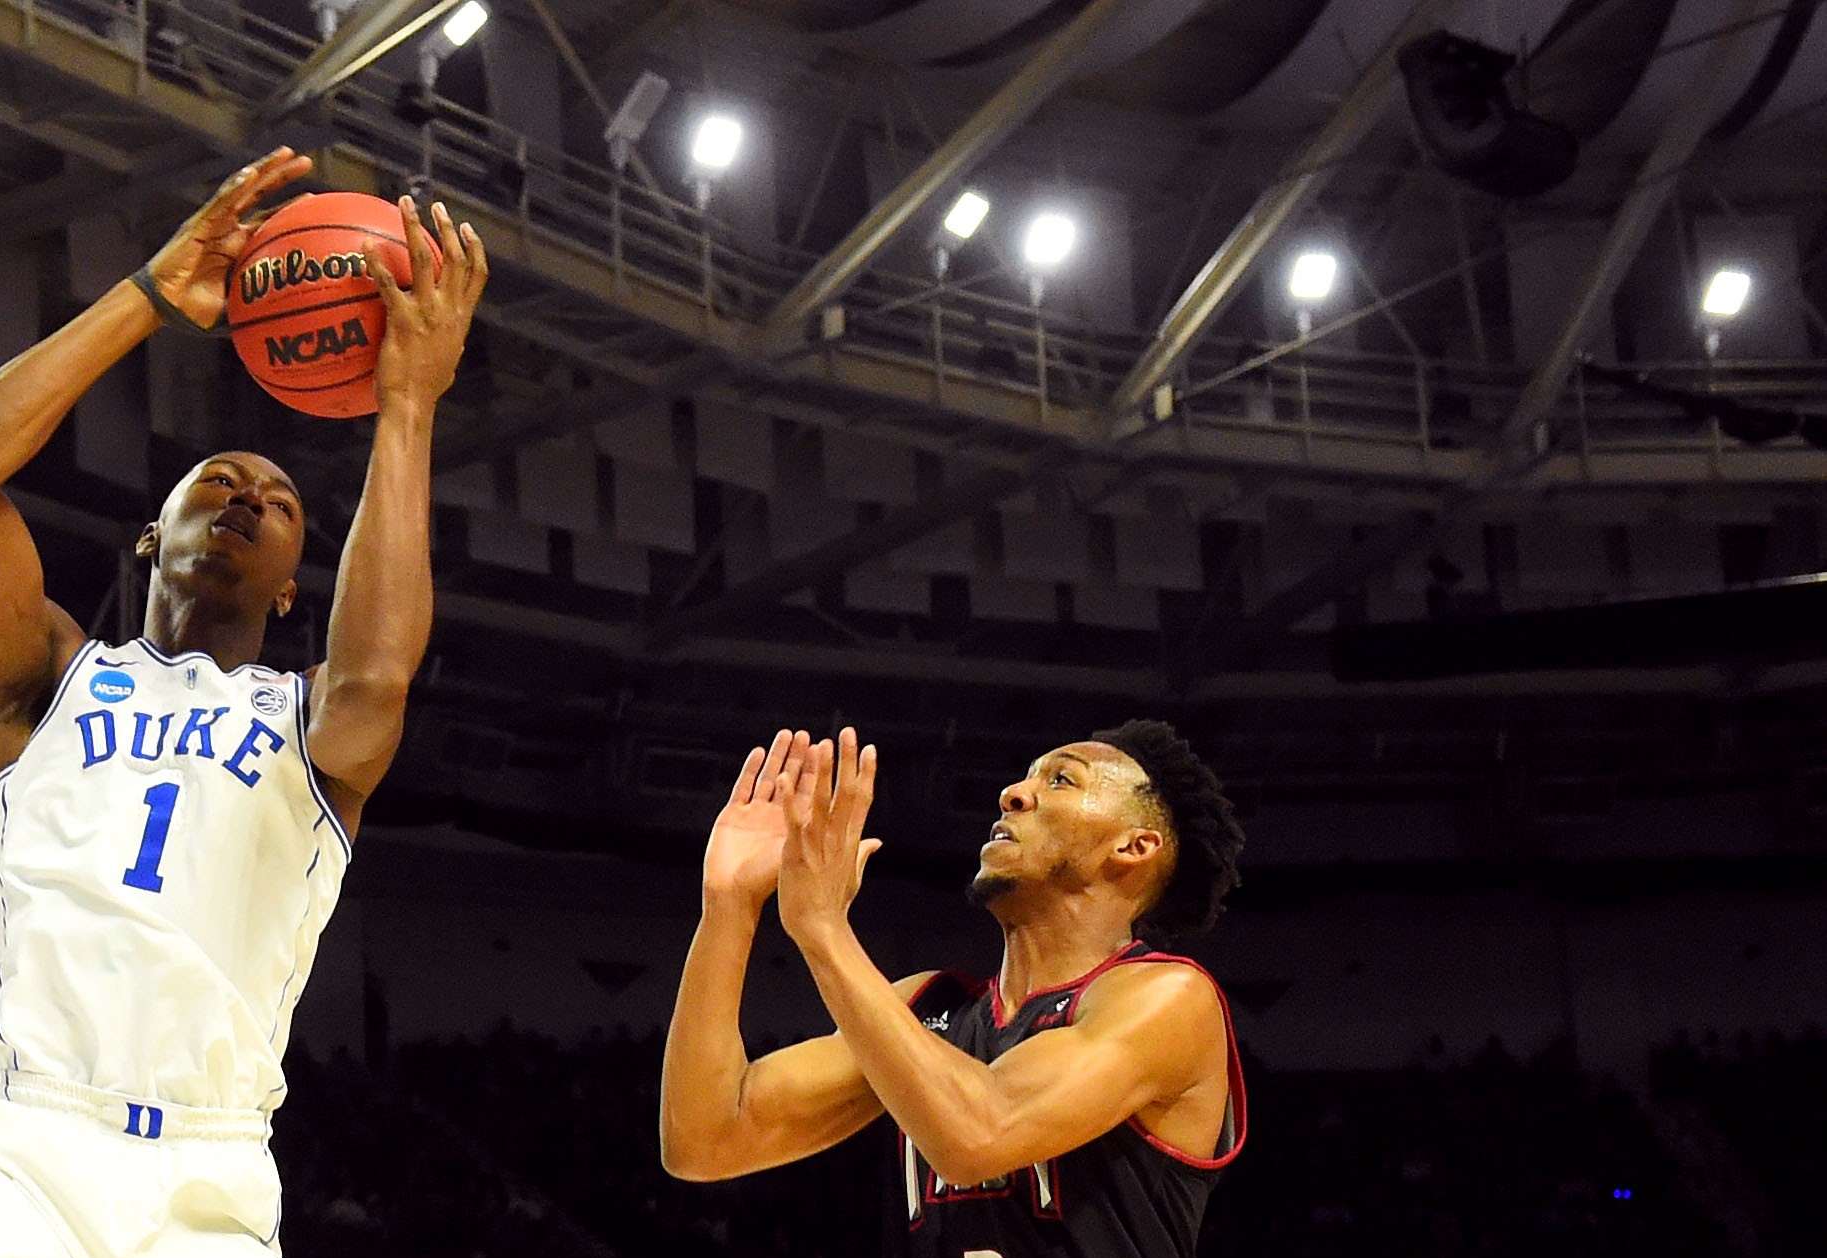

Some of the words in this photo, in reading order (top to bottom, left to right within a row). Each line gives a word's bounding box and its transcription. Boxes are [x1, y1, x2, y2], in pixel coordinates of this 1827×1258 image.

[241, 248, 372, 304] Wilson
[265, 318, 369, 366] NCAA
[75, 706, 285, 788] DUKE
[122, 782, 180, 893] 1
